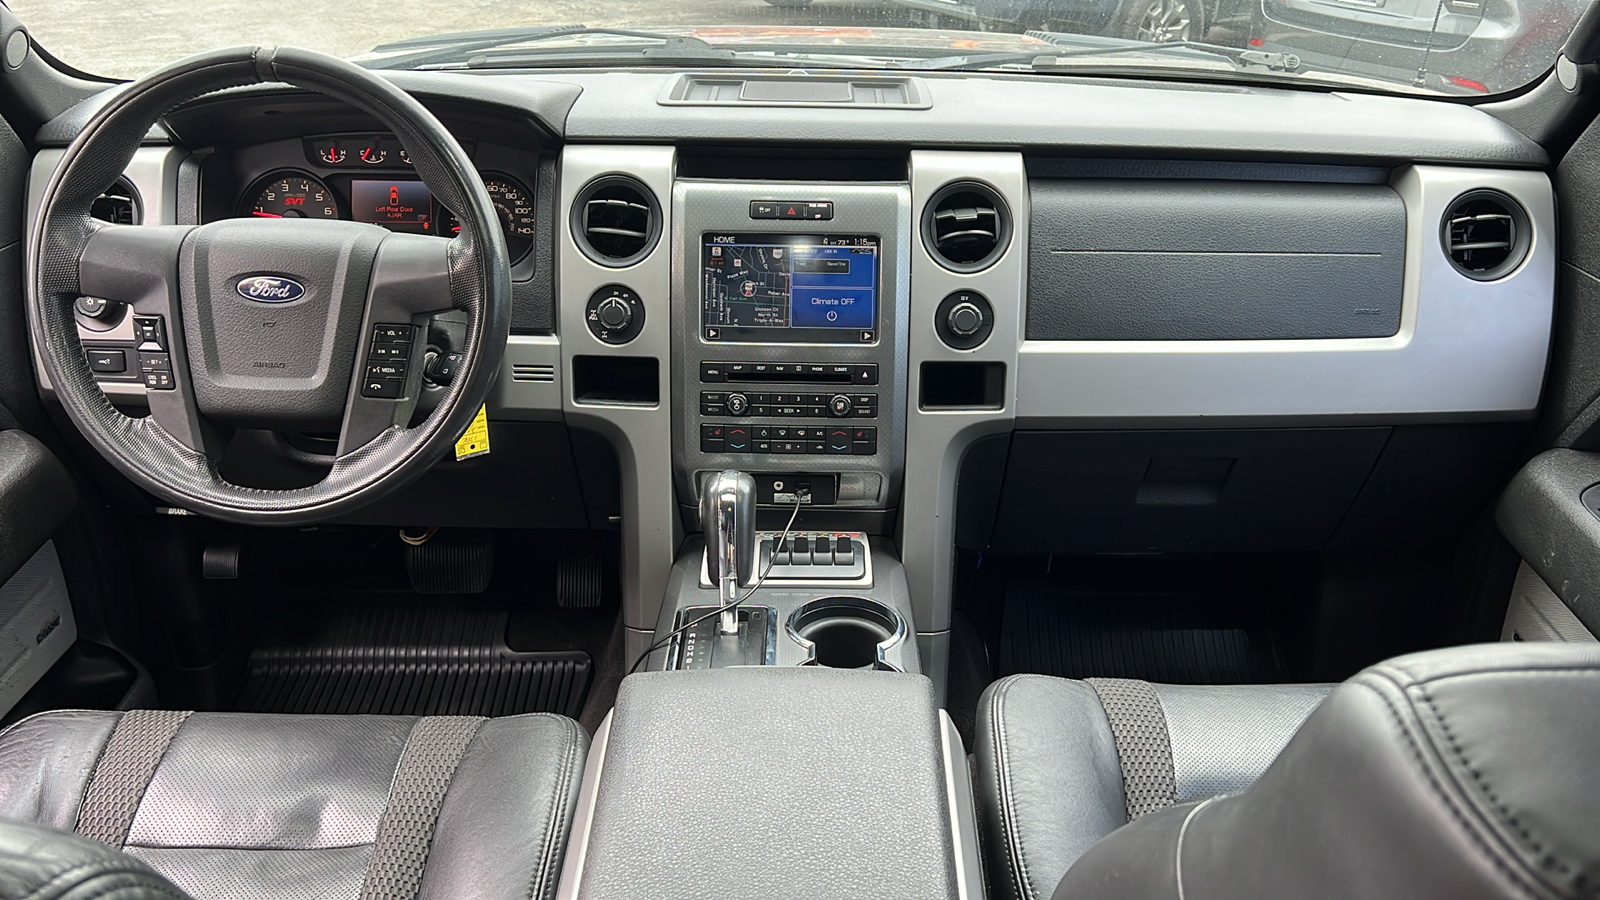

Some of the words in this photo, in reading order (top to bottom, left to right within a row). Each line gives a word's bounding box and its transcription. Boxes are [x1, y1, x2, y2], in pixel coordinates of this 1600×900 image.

[281, 184, 289, 192] 3
[301, 184, 309, 192] 4
[267, 192, 275, 200] 2
[315, 193, 323, 201] 5
[324, 207, 332, 215] 6
[713, 236, 735, 244] HOME
[249, 279, 290, 298] Ford
[168, 508, 188, 516] BRAKE
